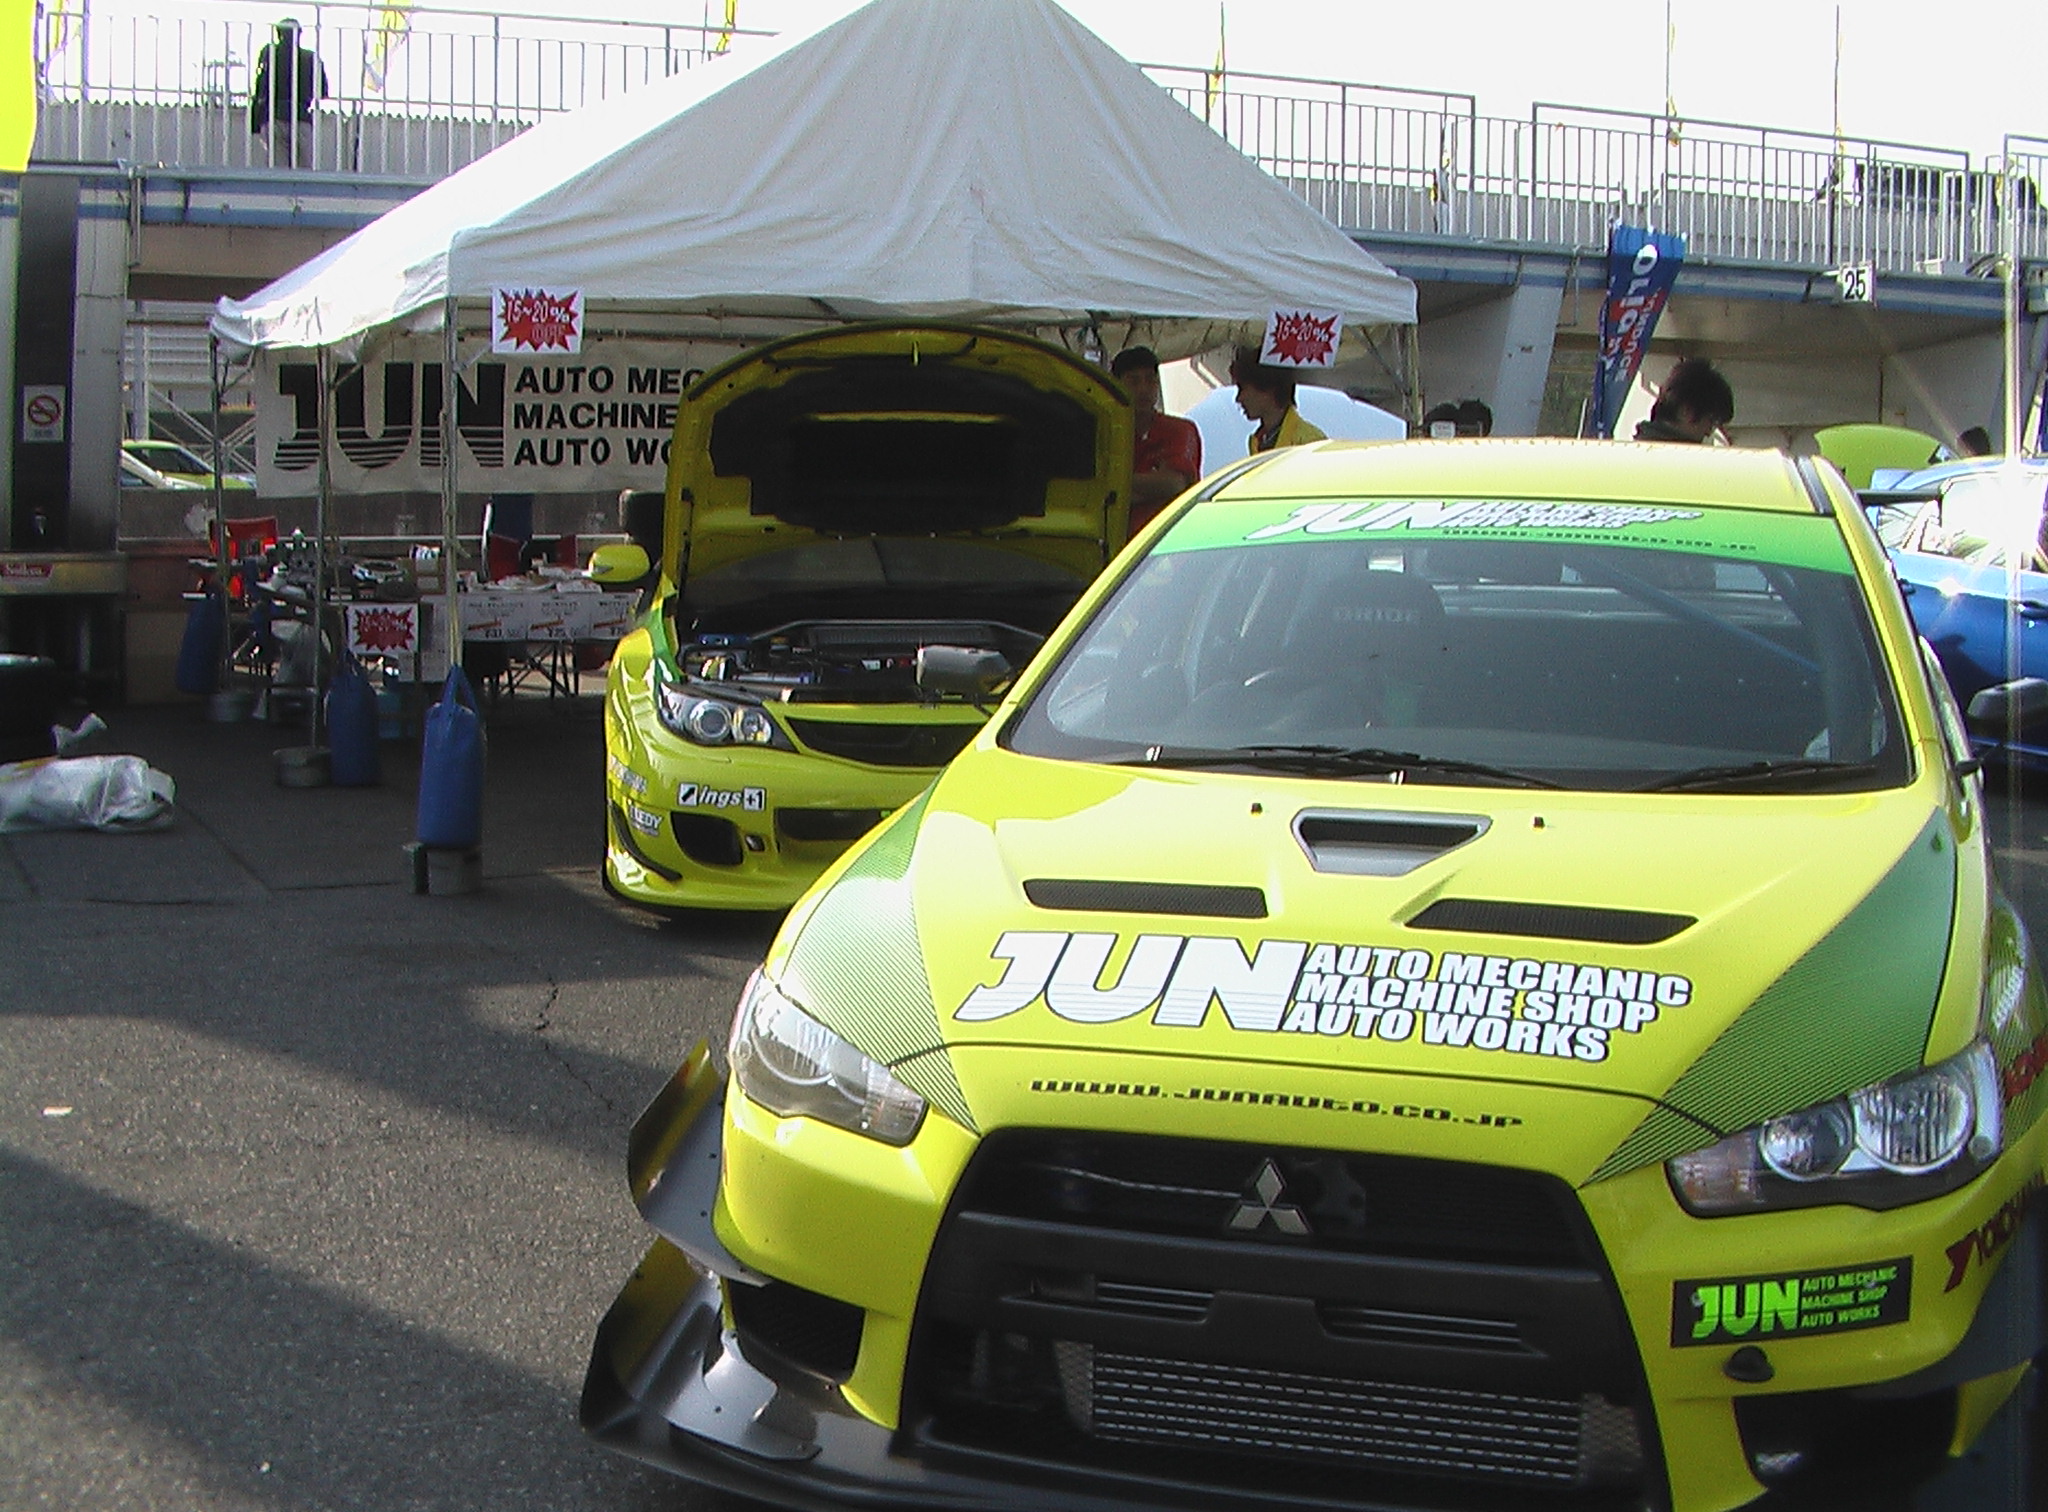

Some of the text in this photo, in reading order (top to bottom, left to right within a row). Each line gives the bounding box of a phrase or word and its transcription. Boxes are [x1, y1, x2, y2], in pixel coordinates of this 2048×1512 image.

[1845, 269, 1866, 299] 25
[514, 366, 614, 394] AUTO
[273, 363, 506, 470] JUN
[514, 403, 676, 430] MACHINE
[514, 438, 610, 467] AUTO
[1243, 502, 1484, 541] JUN
[952, 931, 1312, 1032] JUN
[1303, 943, 1693, 1007] AUTO MECHANIC
[1295, 972, 1660, 1033] MACHINE SHOP
[1282, 1002, 1610, 1062] AUTO WORKS
[1801, 1265, 1898, 1292] AUTO MECHANIC
[1691, 1278, 1800, 1340] JUN
[1801, 1284, 1888, 1309] MACHINE SHOP
[1801, 1305, 1881, 1328] AUTO WORKS
